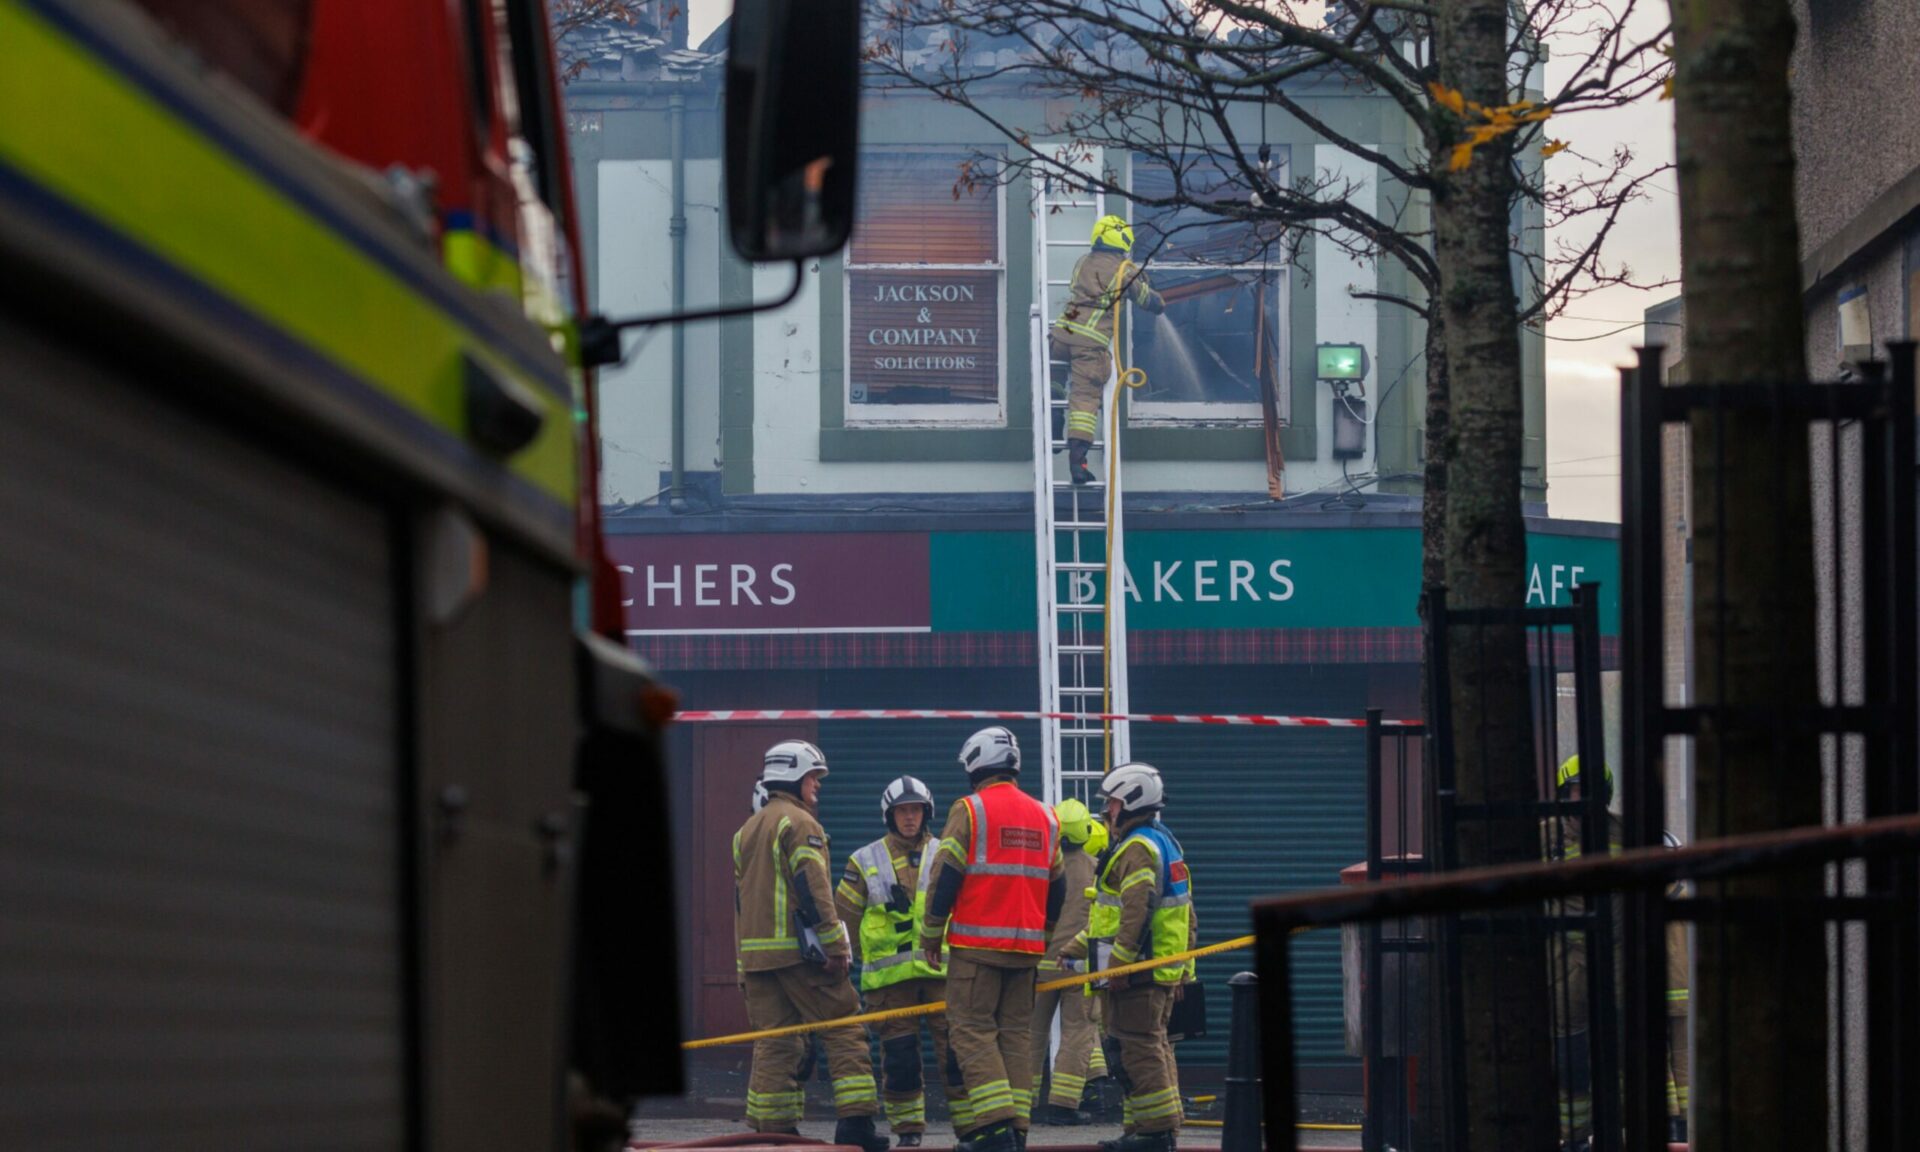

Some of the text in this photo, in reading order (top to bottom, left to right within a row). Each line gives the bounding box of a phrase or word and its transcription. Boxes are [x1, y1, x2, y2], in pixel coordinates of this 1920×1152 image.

[874, 285, 975, 302] JACKSON
[917, 307, 931, 323] &
[869, 328, 979, 345] COMPANY
[874, 356, 976, 369] SOLICITORS
